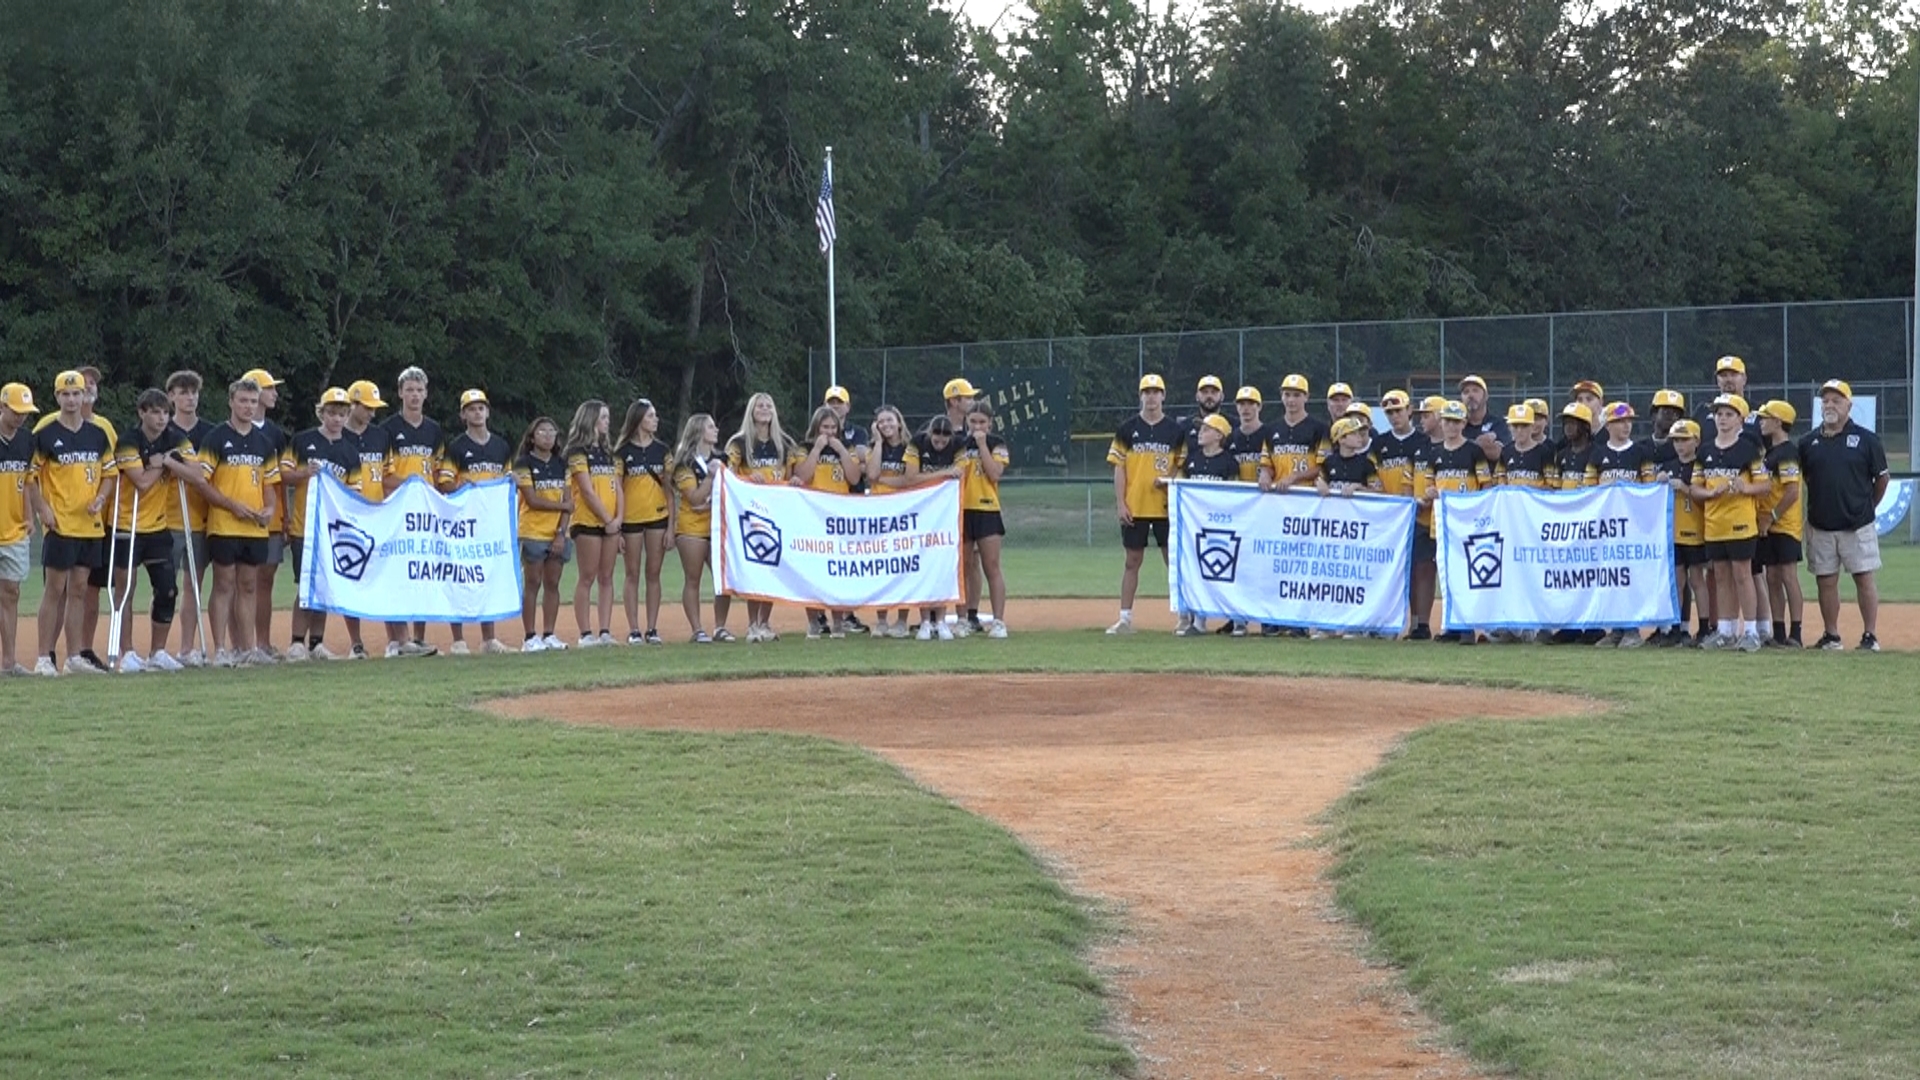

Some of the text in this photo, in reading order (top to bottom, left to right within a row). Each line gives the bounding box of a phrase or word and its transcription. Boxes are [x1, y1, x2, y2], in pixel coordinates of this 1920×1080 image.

[58, 452, 98, 464] SOUTHEAS
[826, 512, 918, 535] SOUTHEAST
[1207, 512, 1233, 524] 2025
[1282, 516, 1370, 540] SOUTHEAST
[1541, 518, 1629, 542] SOUTHEAST
[790, 531, 954, 556] JUNIOR LEAGUE SOFTBALL
[1253, 538, 1395, 564] INTERMEDIATE DIVISION
[1513, 546, 1549, 563] LITTLE
[1551, 548, 1599, 564] LEAGUE
[827, 554, 920, 577] CHAMPIONS
[1273, 558, 1373, 581] 50/70 BASEBALL
[1544, 566, 1631, 589] CHAMPIONS
[1279, 580, 1366, 605] CHAMPIONS
